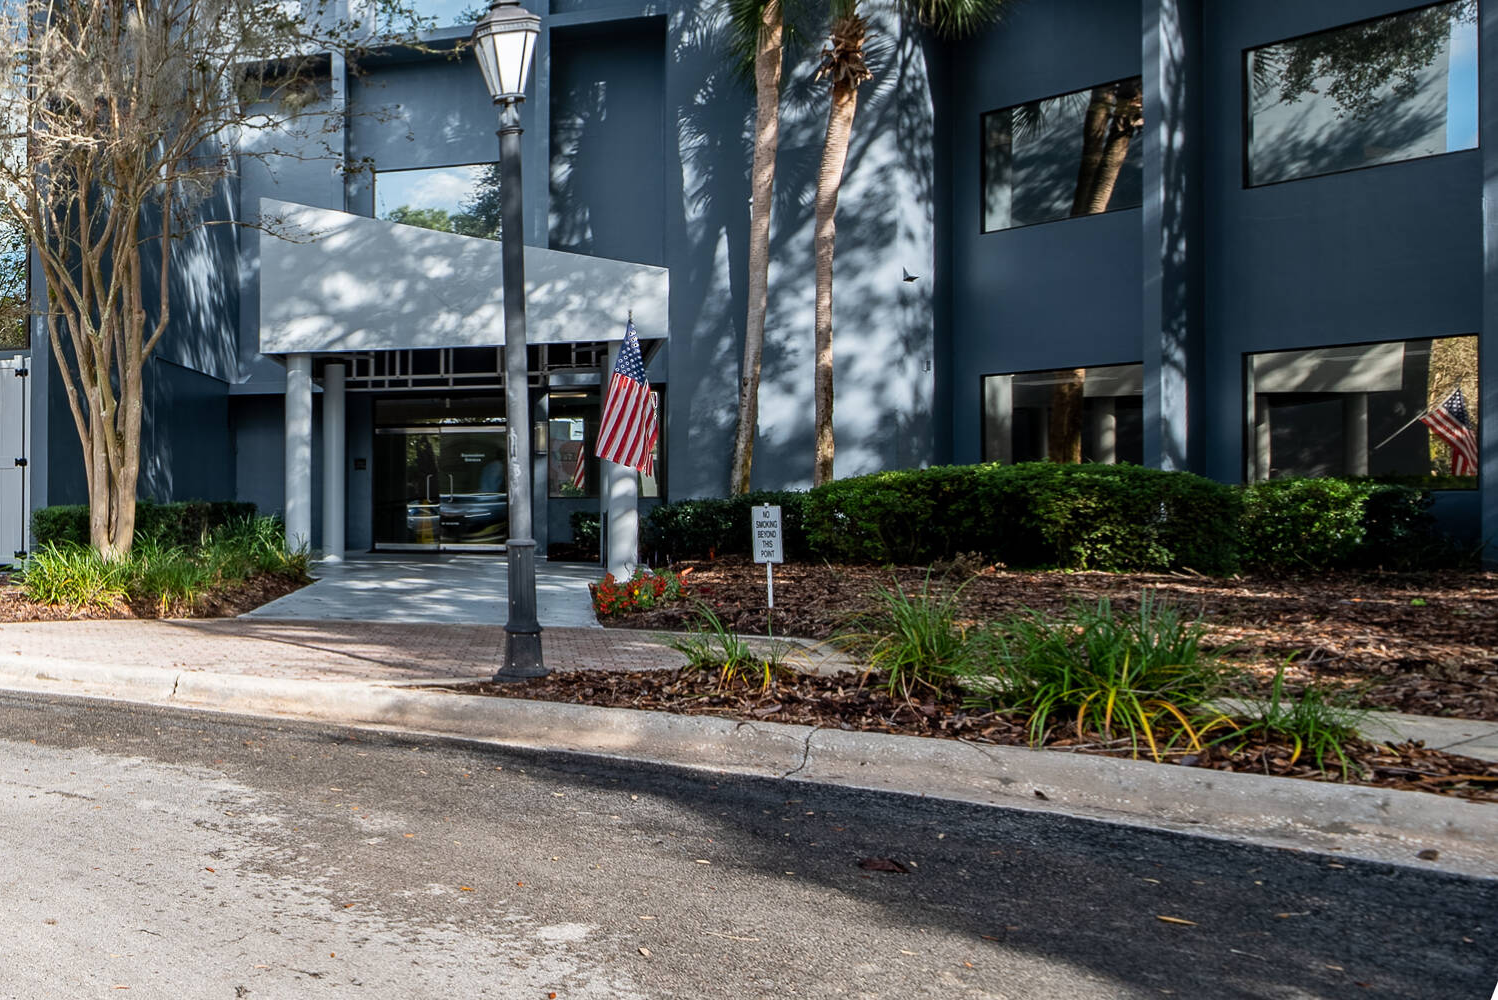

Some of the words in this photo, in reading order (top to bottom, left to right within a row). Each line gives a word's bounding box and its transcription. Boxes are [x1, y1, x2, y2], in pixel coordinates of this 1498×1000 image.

[762, 510, 770, 519] NO
[755, 520, 778, 529] SMOKING
[757, 530, 777, 539] BEYOND
[762, 540, 773, 548] THIS
[761, 550, 775, 558] POINT
